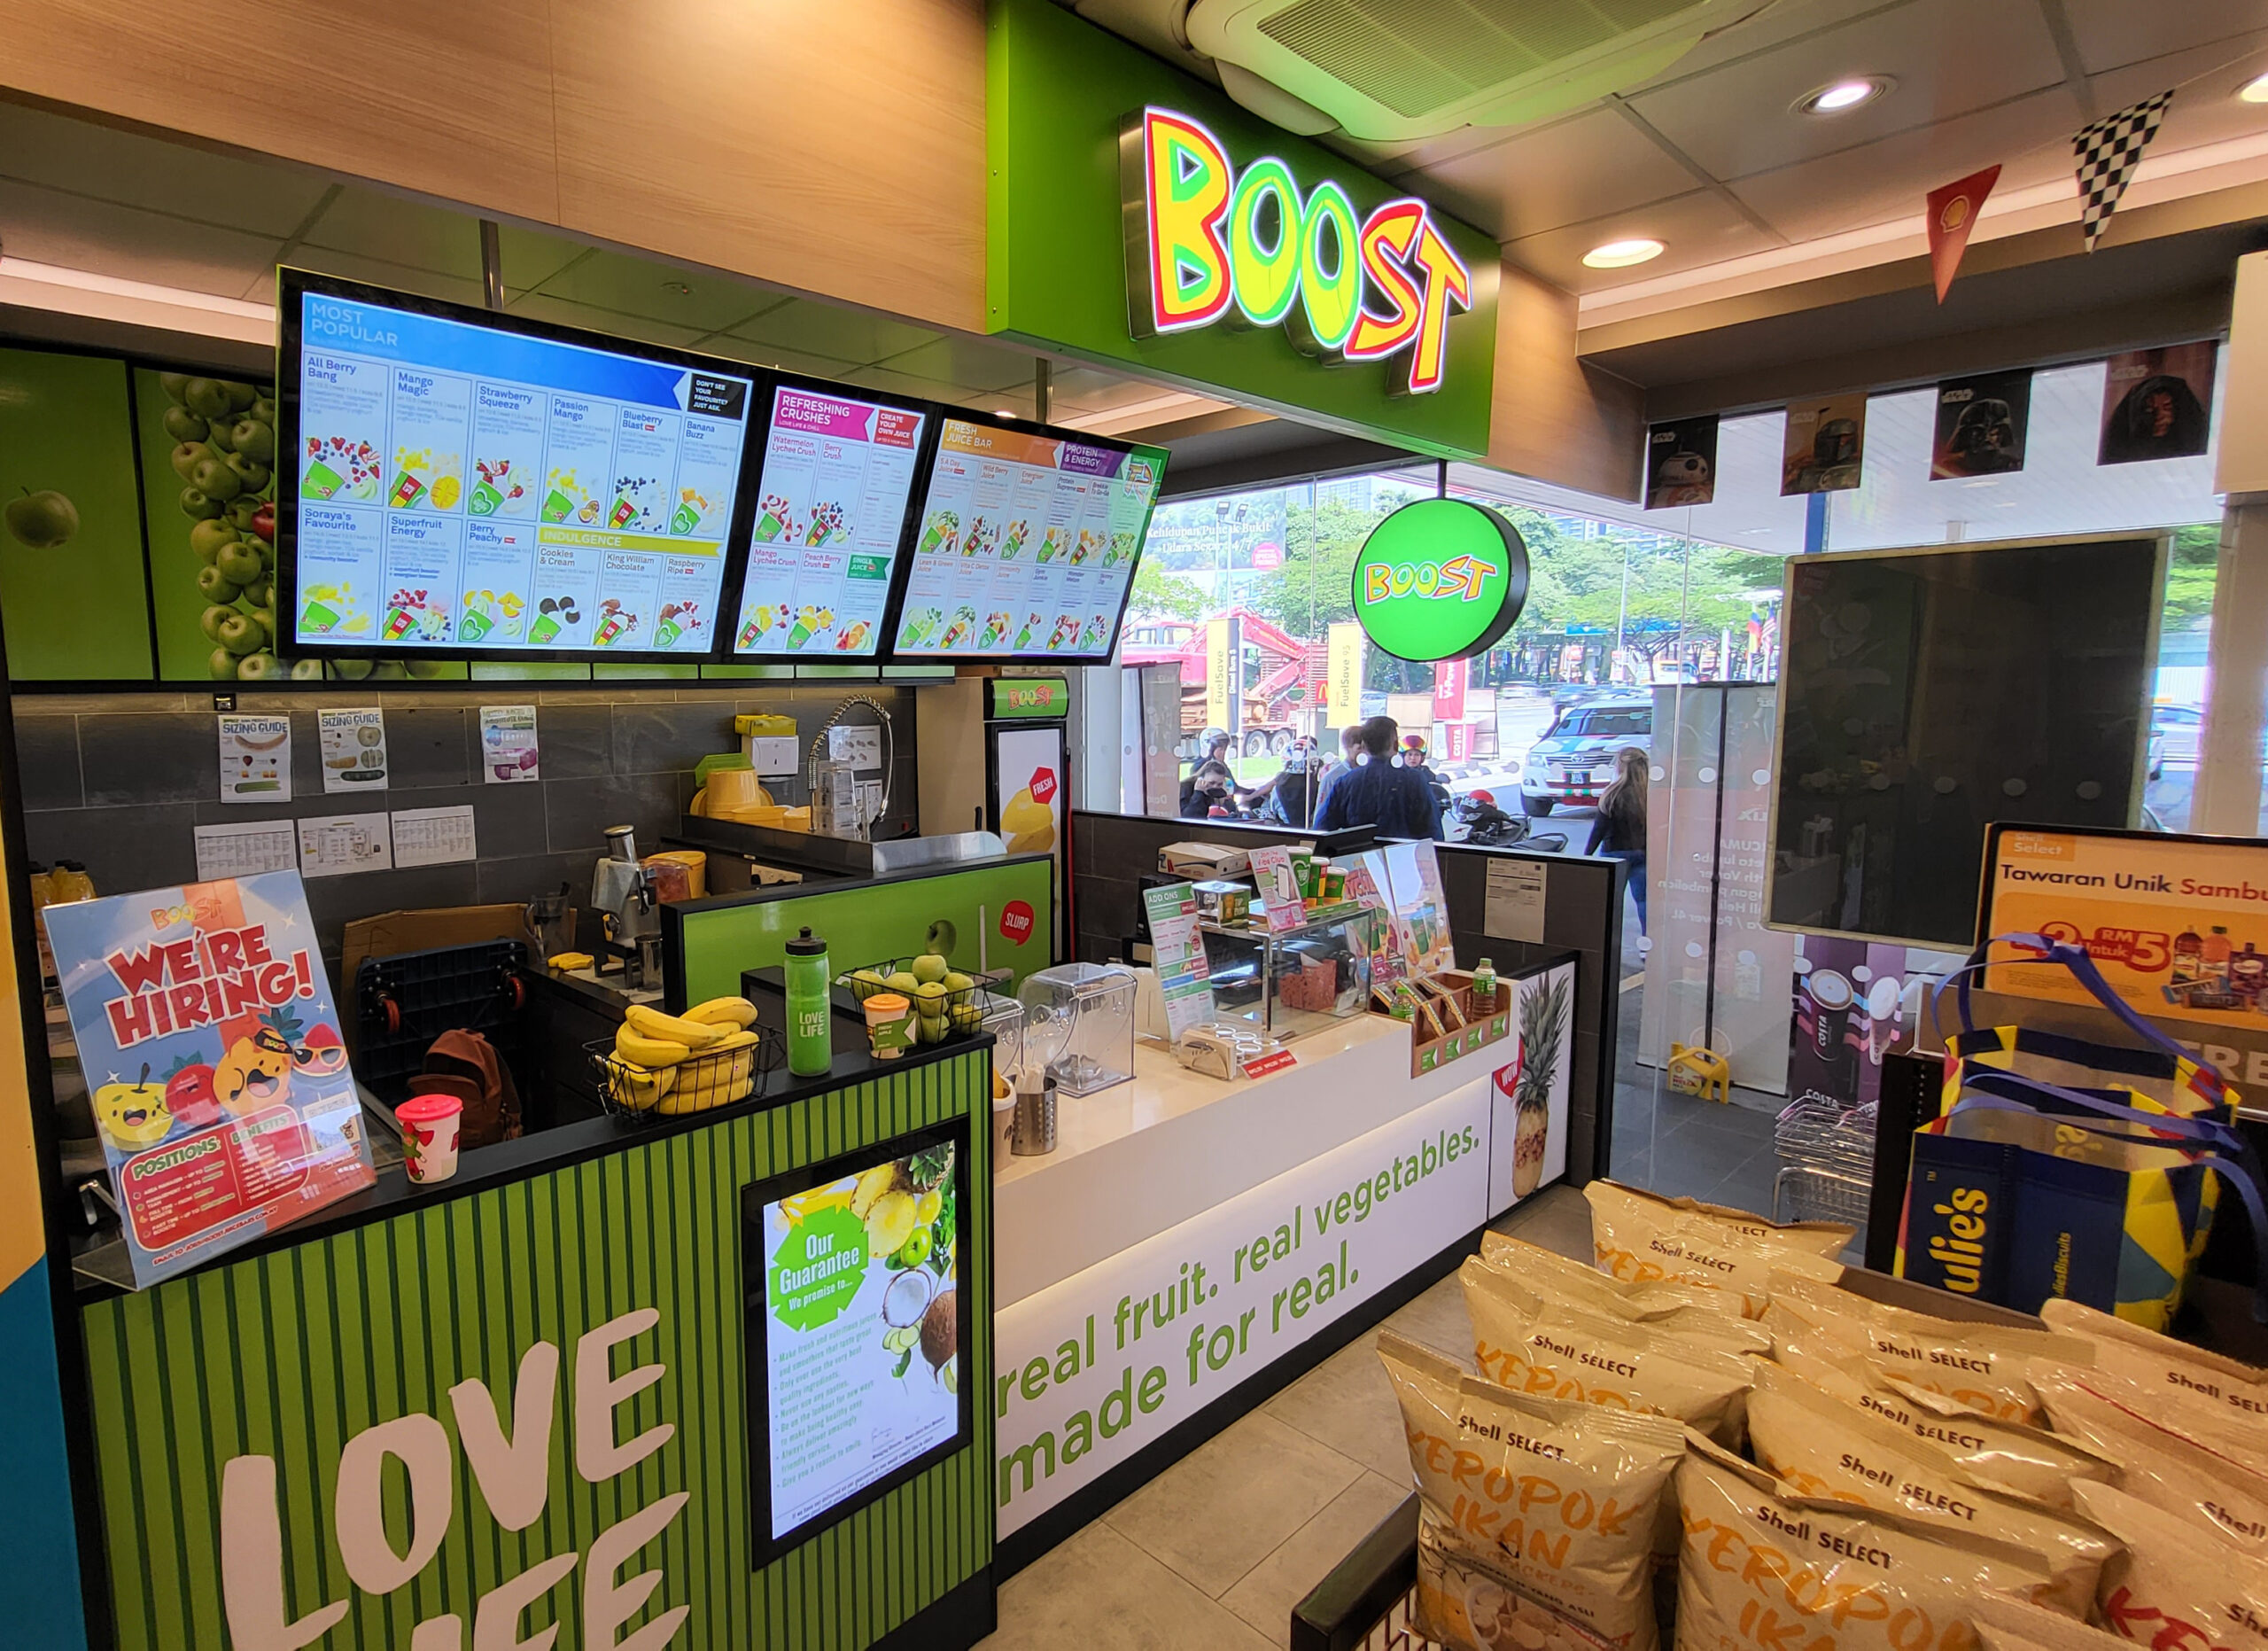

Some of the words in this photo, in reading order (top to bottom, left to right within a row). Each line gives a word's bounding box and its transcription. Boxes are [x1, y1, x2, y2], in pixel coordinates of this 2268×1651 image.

[1144, 104, 1472, 395] BOOST
[311, 302, 364, 323] MOST
[311, 318, 398, 347] POPULAR
[307, 356, 323, 368] All
[326, 360, 357, 376] Berry
[307, 367, 338, 383] Bang
[399, 371, 433, 387] Mango
[398, 382, 430, 396] Magic
[695, 379, 714, 388] DON'T
[695, 386, 711, 395] YOUR
[479, 385, 533, 404] Strawberry
[479, 395, 520, 410] Squeeze
[555, 398, 589, 412] Passion
[781, 394, 850, 417] REFRESHING
[554, 408, 584, 422] Mango
[623, 410, 663, 426] Blueberry
[780, 407, 831, 425] CRUSHES
[880, 413, 904, 423] CREATE
[622, 419, 644, 431] Blast
[687, 420, 715, 432] Banana
[879, 420, 897, 429] YOUR
[948, 422, 977, 435] FRESH
[686, 429, 704, 440] Buzz
[878, 427, 894, 436] OWN
[893, 430, 911, 439] JUICE
[946, 433, 972, 446] JUICE
[974, 438, 992, 448] BAR
[772, 443, 796, 455] Lychee
[797, 446, 817, 456] Crush
[773, 435, 814, 448] Watermelon
[824, 443, 842, 453] Berry
[823, 451, 842, 461] Crush
[1066, 444, 1098, 456] PROTEIN
[1071, 455, 1100, 467] ENERGY
[304, 508, 352, 522] Soraya's
[391, 516, 443, 529] Superfruit
[304, 518, 356, 531] Favourite
[391, 526, 426, 538] Energy
[470, 523, 495, 534] Berry
[1242, 521, 1270, 533] Bukit
[469, 532, 502, 544] Peachy
[543, 530, 623, 547] INDULGENCE
[1161, 541, 1193, 554] Udara
[1225, 538, 1253, 551] 4/7
[540, 548, 574, 558] Cookies
[607, 553, 625, 564] King
[626, 554, 655, 565] William
[753, 557, 777, 565] Lychee
[754, 549, 778, 559] Mango
[825, 555, 842, 564] Berry
[548, 557, 576, 567] Cream
[606, 561, 645, 572] Chocolate
[668, 557, 706, 570] Raspberry
[667, 566, 684, 575] Ripe
[1364, 554, 1498, 604] BOOST
[1342, 644, 1350, 657] 95
[1215, 650, 1224, 705] FuelSave
[1228, 672, 1238, 695] Diesel
[1340, 658, 1350, 707] FuelSave
[1008, 684, 1054, 711] BOOST
[258, 721, 288, 733] GUIDE
[353, 713, 381, 725] GUIDE
[1453, 729, 1462, 756] COSTA
[1032, 776, 1053, 796] FRESH
[2013, 841, 2062, 856] Select
[2000, 863, 2106, 888] Tawaran
[2114, 872, 2173, 893] Unik
[1148, 894, 1163, 904] ADD
[1164, 891, 1178, 900] ONS
[150, 897, 223, 931] BOOST
[1005, 912, 1029, 931] SLURP
[2102, 930, 2133, 943] RM
[2130, 931, 2167, 972] 5
[103, 923, 273, 997] WE'RE
[104, 948, 315, 1051] HIRING!
[799, 1010, 825, 1025] LOVE
[799, 1023, 825, 1039] LIFE
[1818, 1015, 1828, 1047] COSTA
[1501, 1061, 1518, 1087] WOW
[1806, 1088, 1840, 1109] COSTA
[132, 1137, 221, 1181] POSITIONS:
[1927, 1171, 1937, 1181] TM
[805, 1233, 835, 1259] Our
[1928, 1188, 1990, 1294] ulie's
[1650, 1240, 1682, 1257] Shell
[1685, 1251, 1736, 1273] SELECT
[780, 1247, 859, 1294] Guarantee
[997, 1314, 1096, 1418] real
[1114, 1260, 1218, 1351] fruit.
[1232, 1204, 1302, 1283] real
[1314, 1125, 1480, 1234] vegetables.
[788, 1297, 802, 1312] We
[803, 1284, 835, 1307] promise
[837, 1280, 853, 1290] to...
[779, 1350, 796, 1363] Make
[1534, 1335, 1575, 1359] Shell
[1580, 1352, 1637, 1379] SELECT
[1877, 1340, 1923, 1361] Shell
[1930, 1351, 1992, 1375] SELECT
[998, 1368, 1168, 1507] made
[1185, 1305, 1256, 1386] for
[1270, 1240, 1360, 1335] real.
[2166, 1371, 2220, 1398] Shell
[2228, 1393, 2268, 1414] SEL
[1859, 1395, 1909, 1428] Shell
[1915, 1423, 1986, 1452] SELECT
[1457, 1415, 1502, 1442] Shell
[1506, 1431, 1565, 1462] SELECT
[221, 1306, 675, 1651] LOVE
[1840, 1453, 1894, 1488] Shell
[1900, 1481, 1977, 1523] SELECT
[2203, 1500, 2266, 1539] Shell
[1452, 1494, 1572, 1570] IKAN
[1757, 1506, 1810, 1541] Shell
[1817, 1531, 1891, 1569] SELECT
